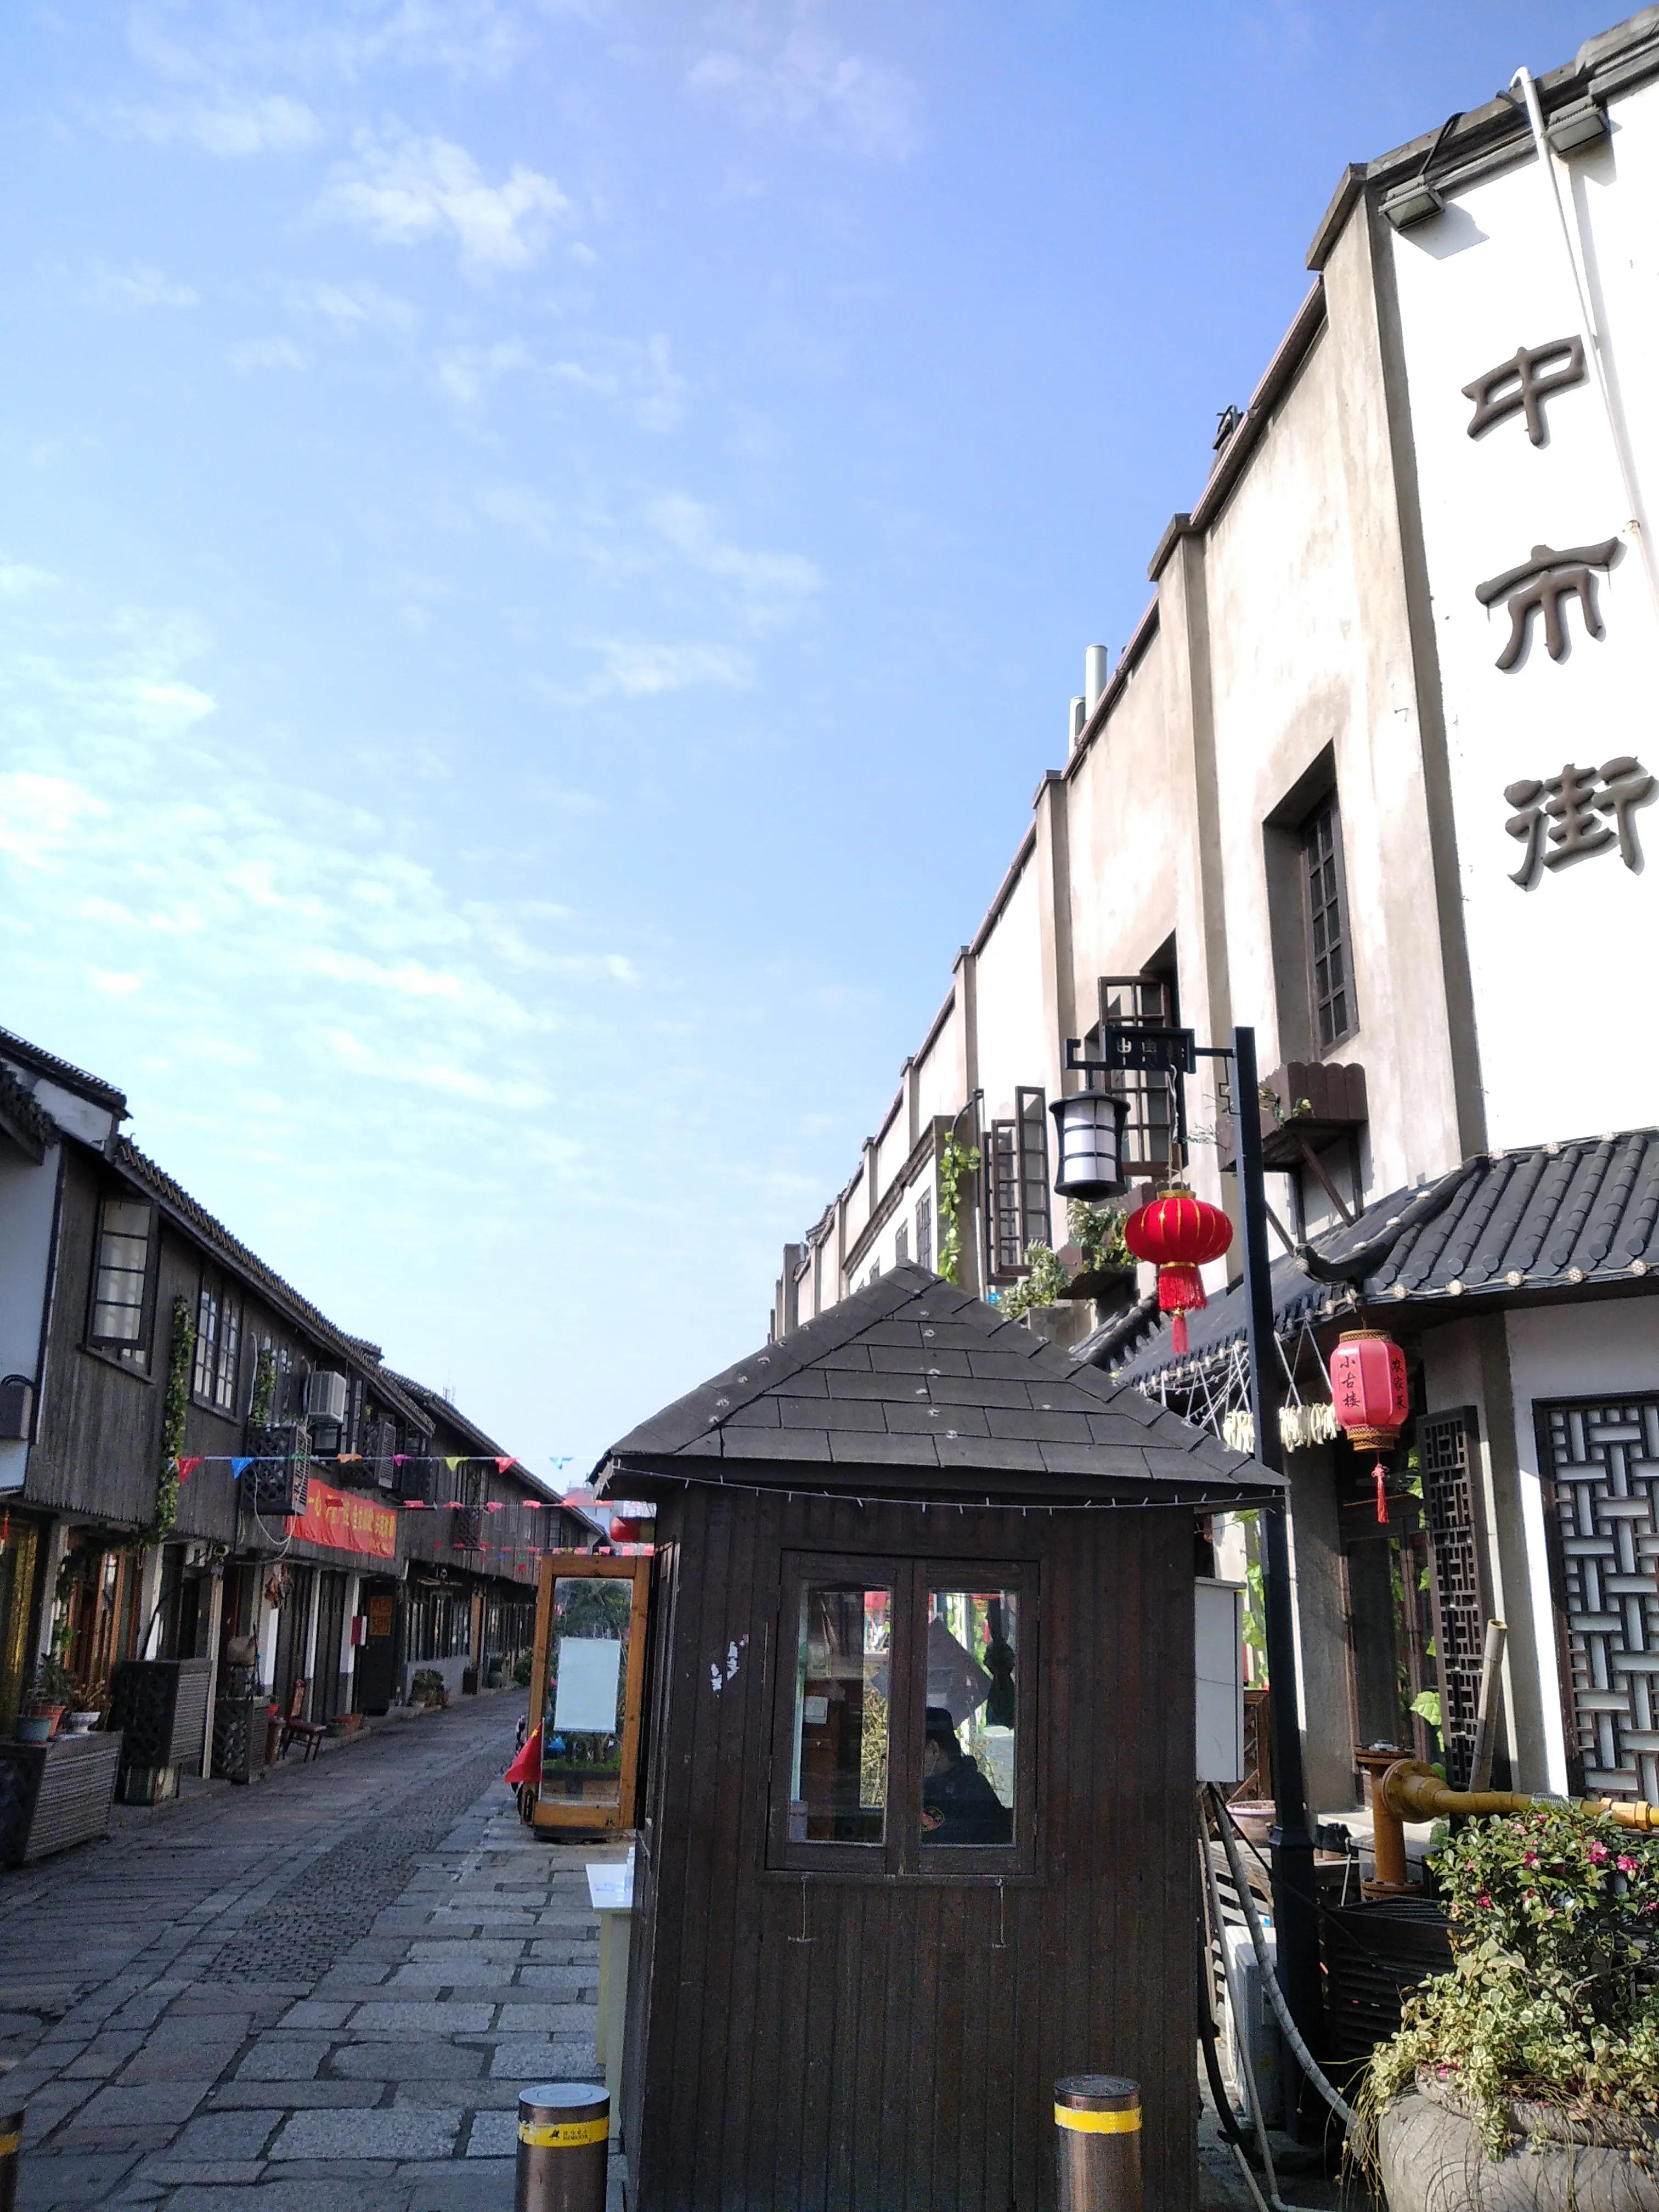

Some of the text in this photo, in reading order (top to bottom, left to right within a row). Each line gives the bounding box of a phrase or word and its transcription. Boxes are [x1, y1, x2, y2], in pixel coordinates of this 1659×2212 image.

[1461, 334, 1658, 891] 中市街
[1340, 1356, 1360, 1407] 小古楼
